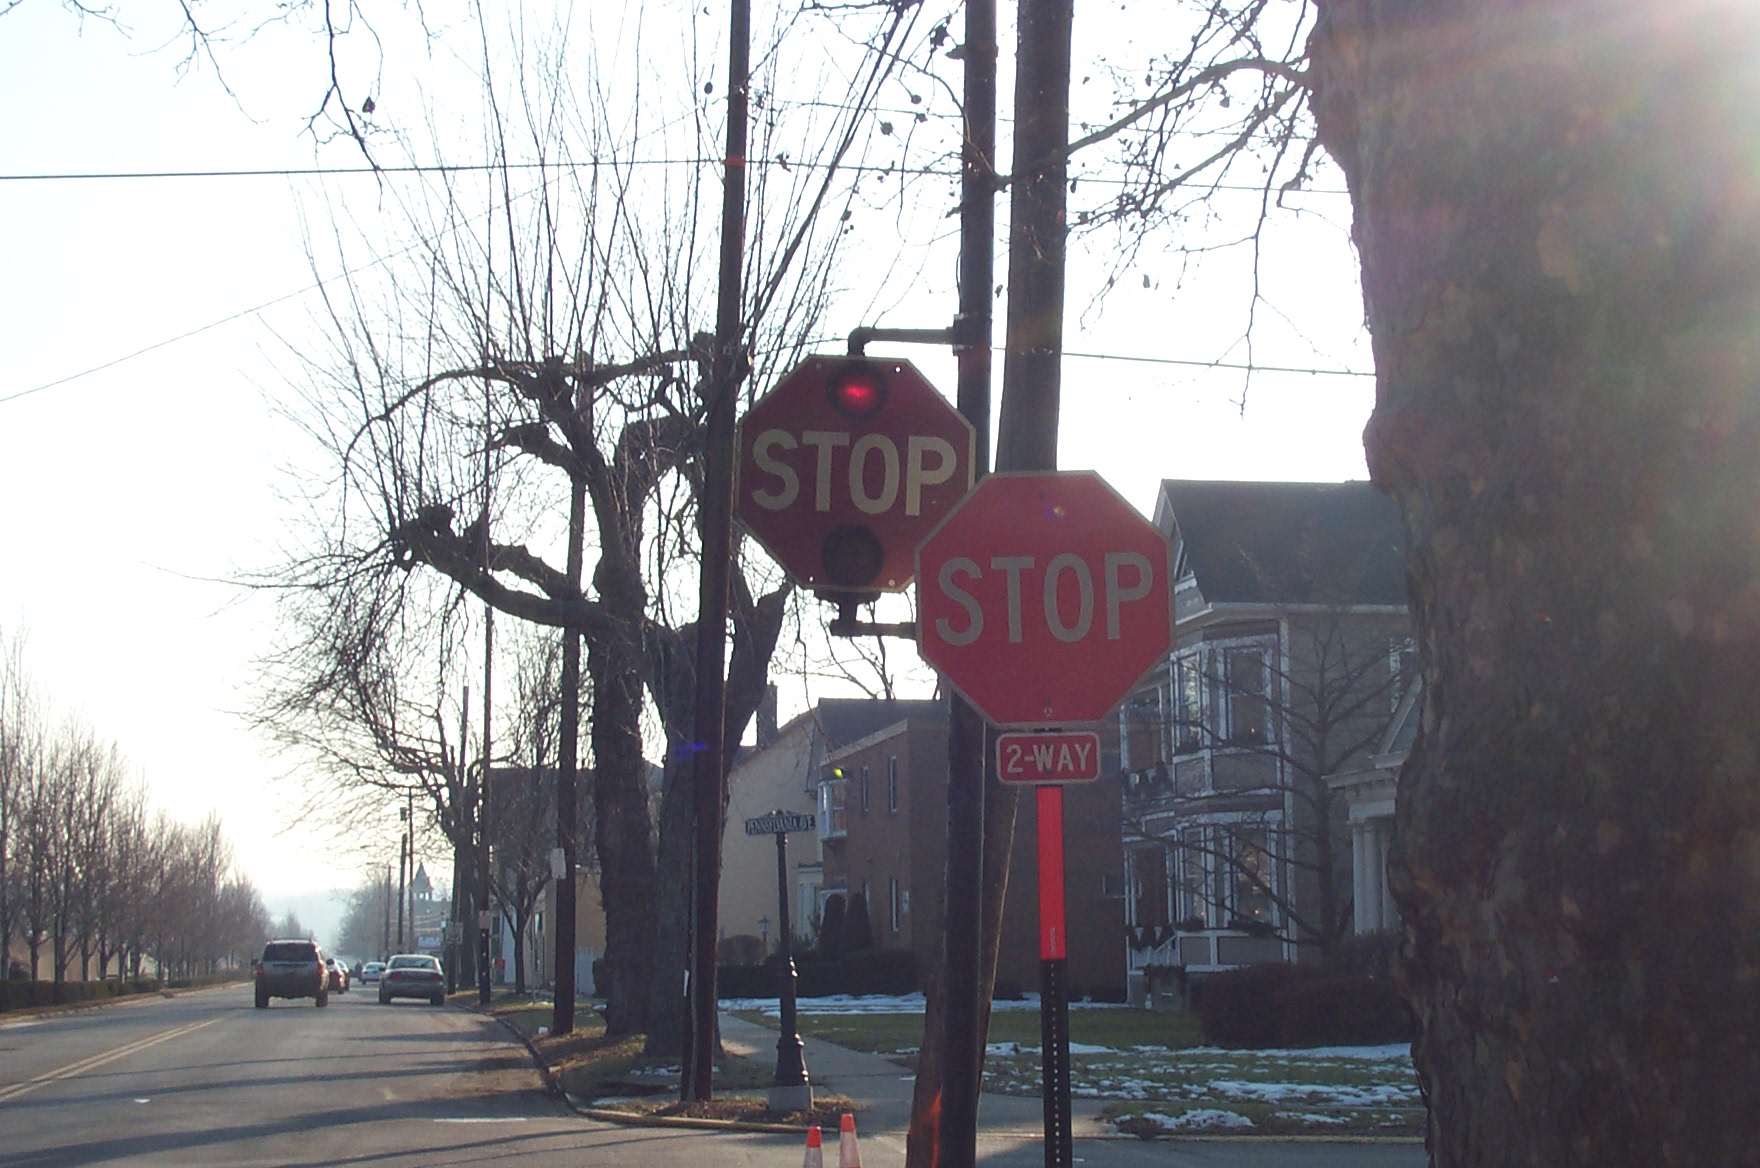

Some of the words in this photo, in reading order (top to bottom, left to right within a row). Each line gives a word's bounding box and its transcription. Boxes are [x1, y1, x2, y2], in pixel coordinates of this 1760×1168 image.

[752, 429, 957, 516] STOP
[935, 552, 1153, 646] STOP
[1006, 743, 1091, 774] 2-WAY
